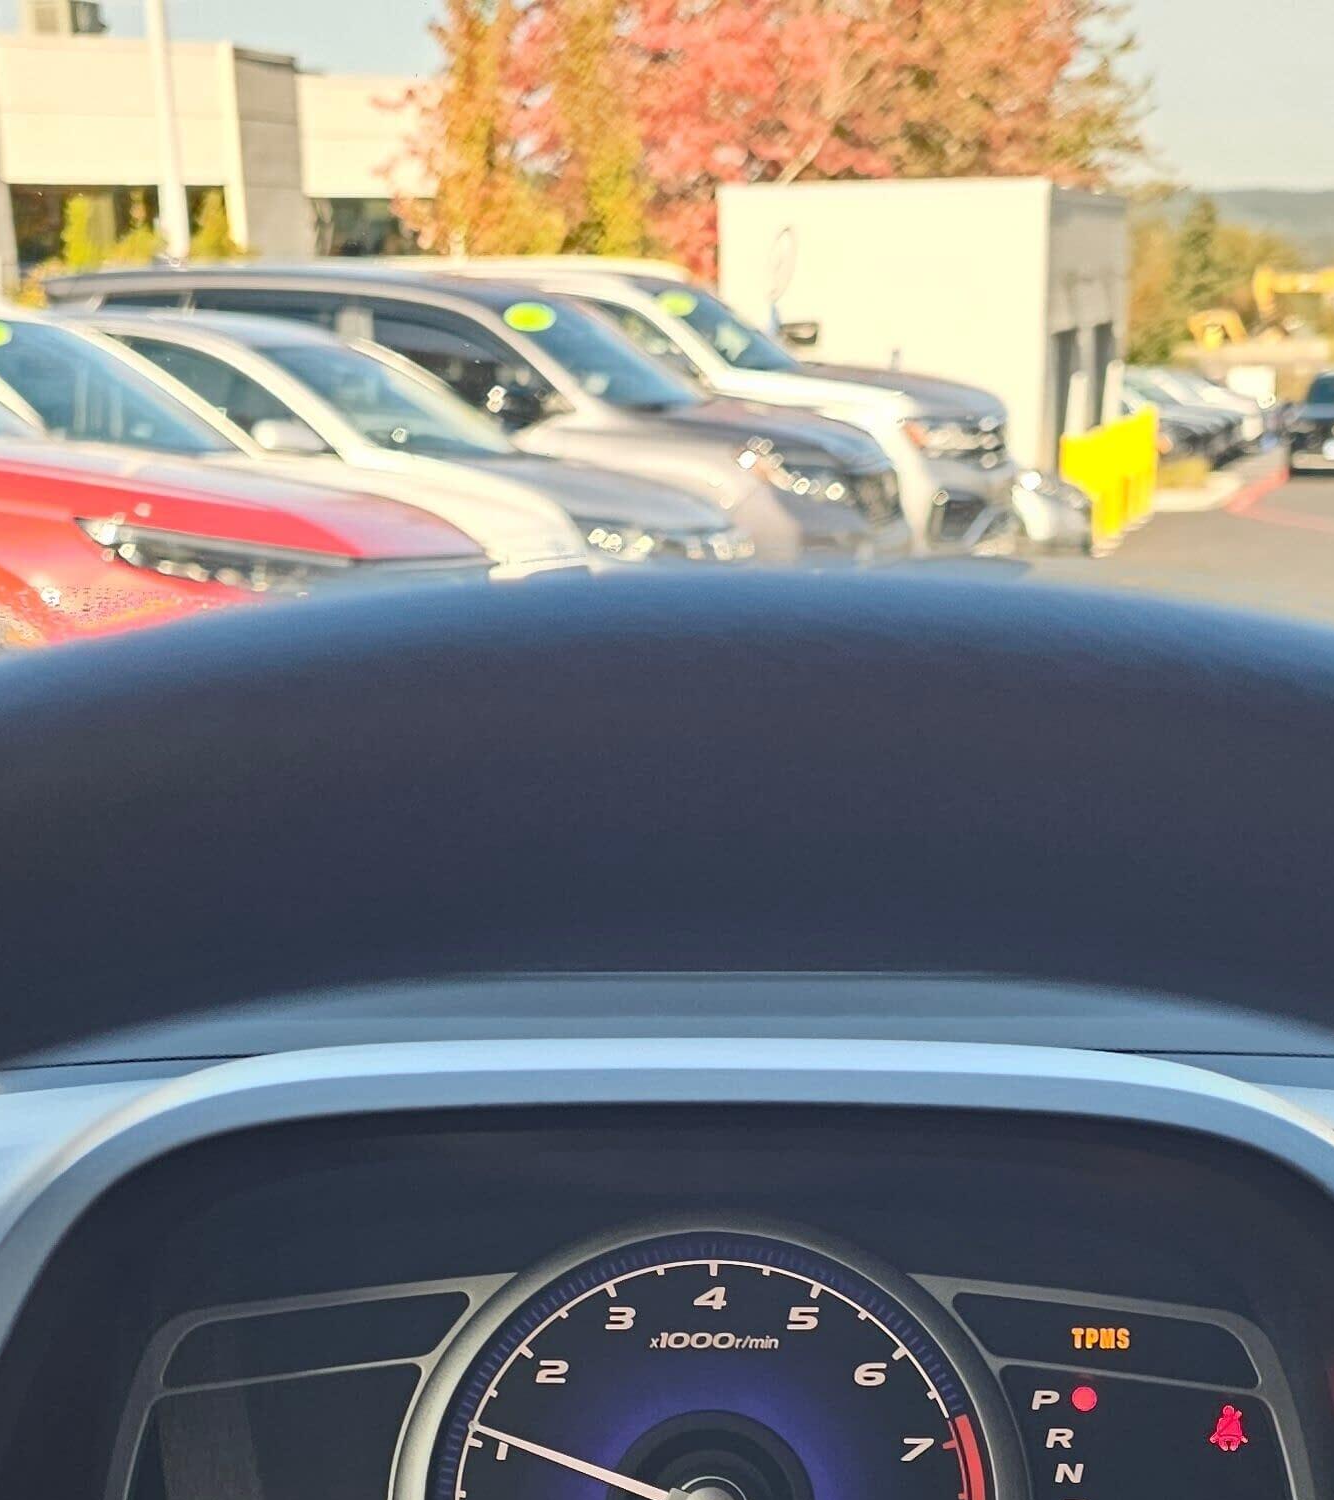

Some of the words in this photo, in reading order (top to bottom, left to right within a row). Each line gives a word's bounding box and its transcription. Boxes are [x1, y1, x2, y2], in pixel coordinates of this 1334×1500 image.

[693, 1286, 727, 1310] 4
[604, 1306, 636, 1330] 3
[786, 1306, 819, 1330] 5
[1071, 1327, 1130, 1349] TPMS
[535, 1359, 569, 1384] 2
[853, 1362, 887, 1386] 6
[1031, 1390, 1060, 1411] P
[900, 1437, 935, 1462] 7
[1045, 1428, 1074, 1449] R
[1054, 1463, 1084, 1484] N
